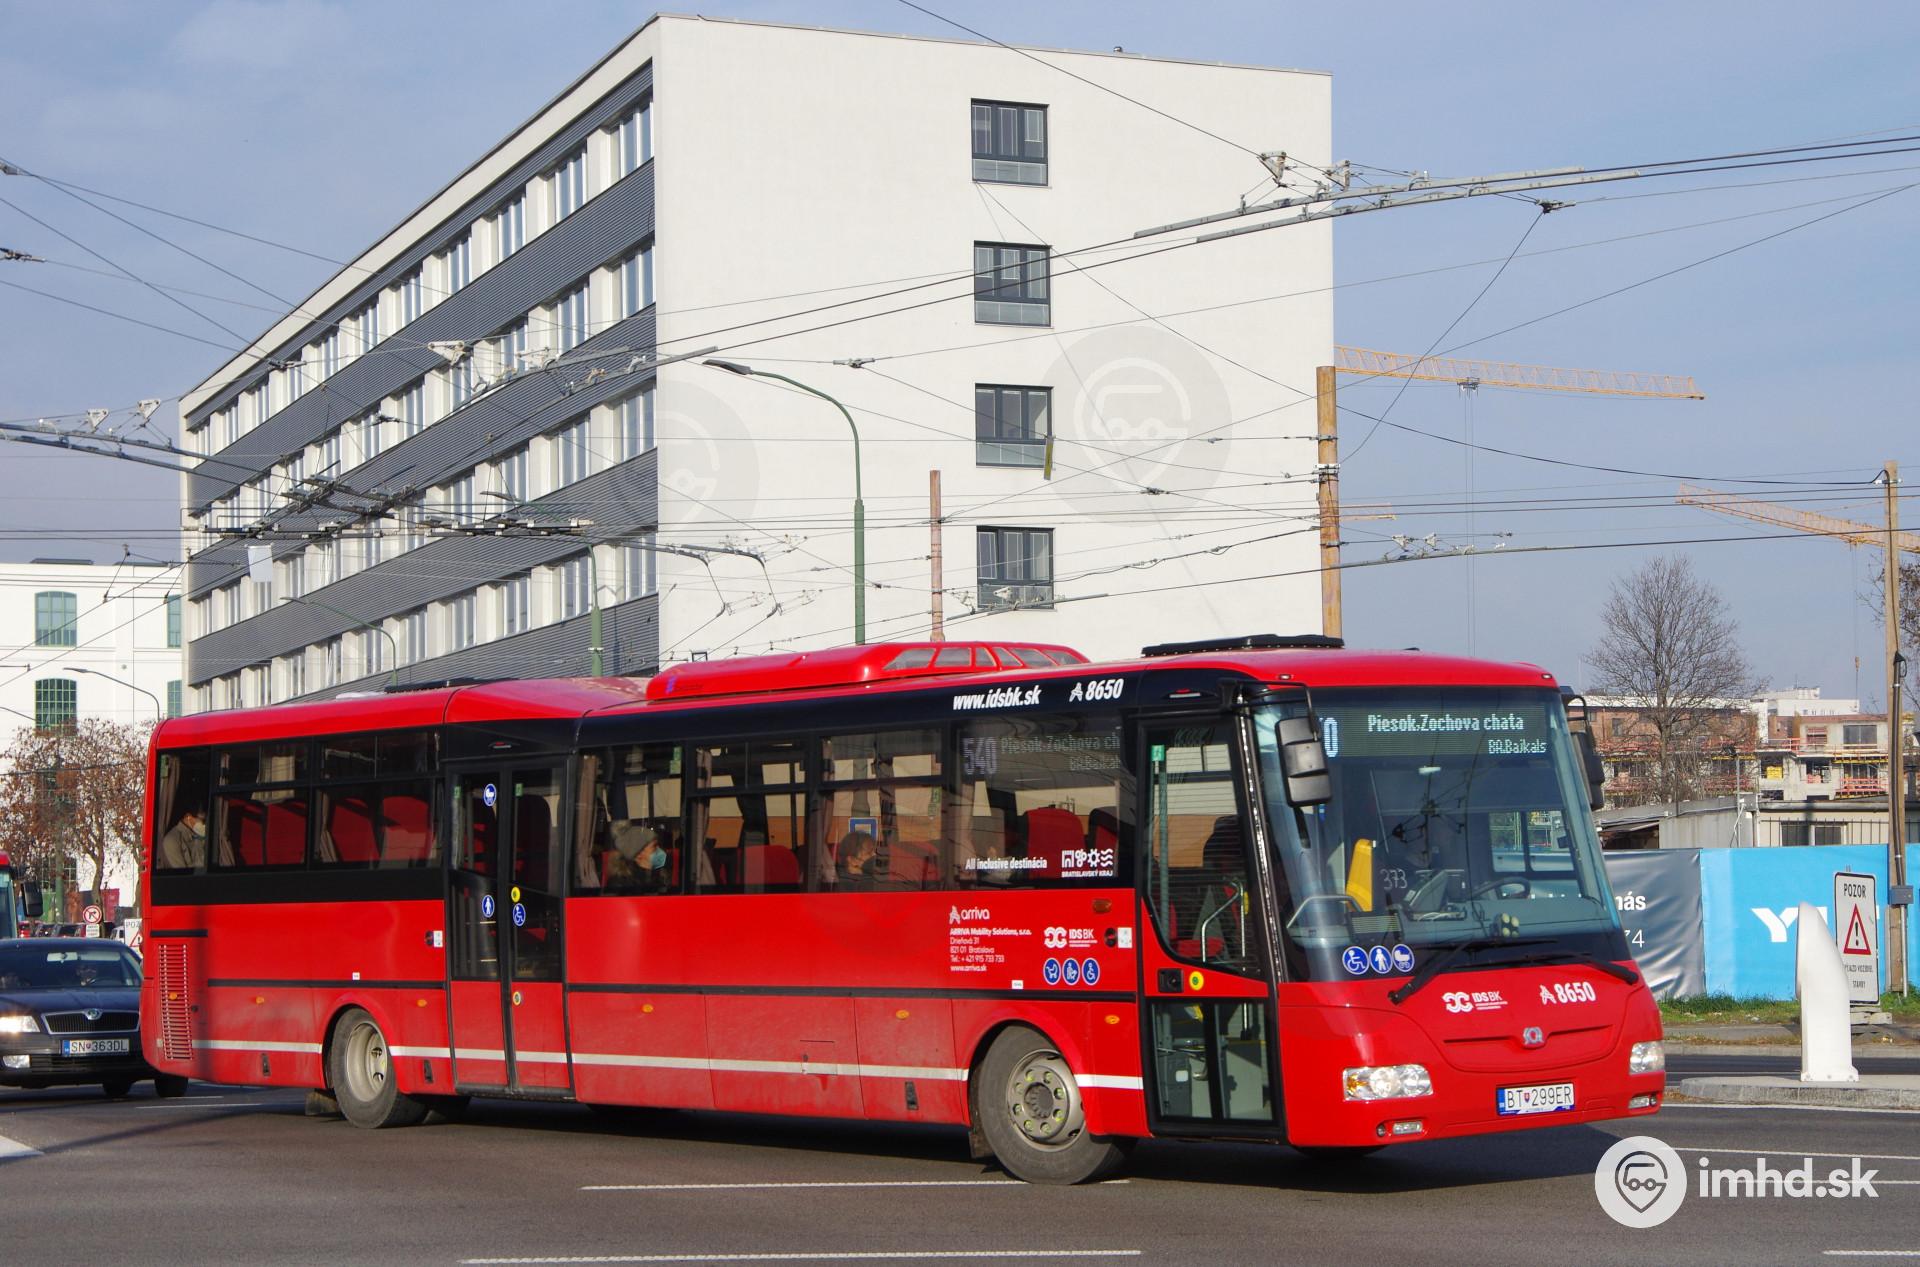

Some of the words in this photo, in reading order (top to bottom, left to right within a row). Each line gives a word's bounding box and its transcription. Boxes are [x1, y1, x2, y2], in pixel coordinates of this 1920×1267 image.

[953, 684, 1042, 710] www.idsbk.sk
[1085, 679, 1124, 701] 8650
[1483, 713, 1524, 731] chata
[962, 736, 998, 774] 540
[965, 858, 976, 870] All
[977, 858, 1008, 870] inclusive
[1010, 856, 1047, 869] destinácia
[1843, 883, 1867, 898] POZOR
[961, 906, 990, 920] arriva
[950, 928, 970, 936] ARRIVA
[970, 928, 992, 937] Mobility
[968, 946, 995, 954] Bratislava
[950, 964, 987, 972] www.arriva.sk
[1553, 981, 1597, 1004] 8650
